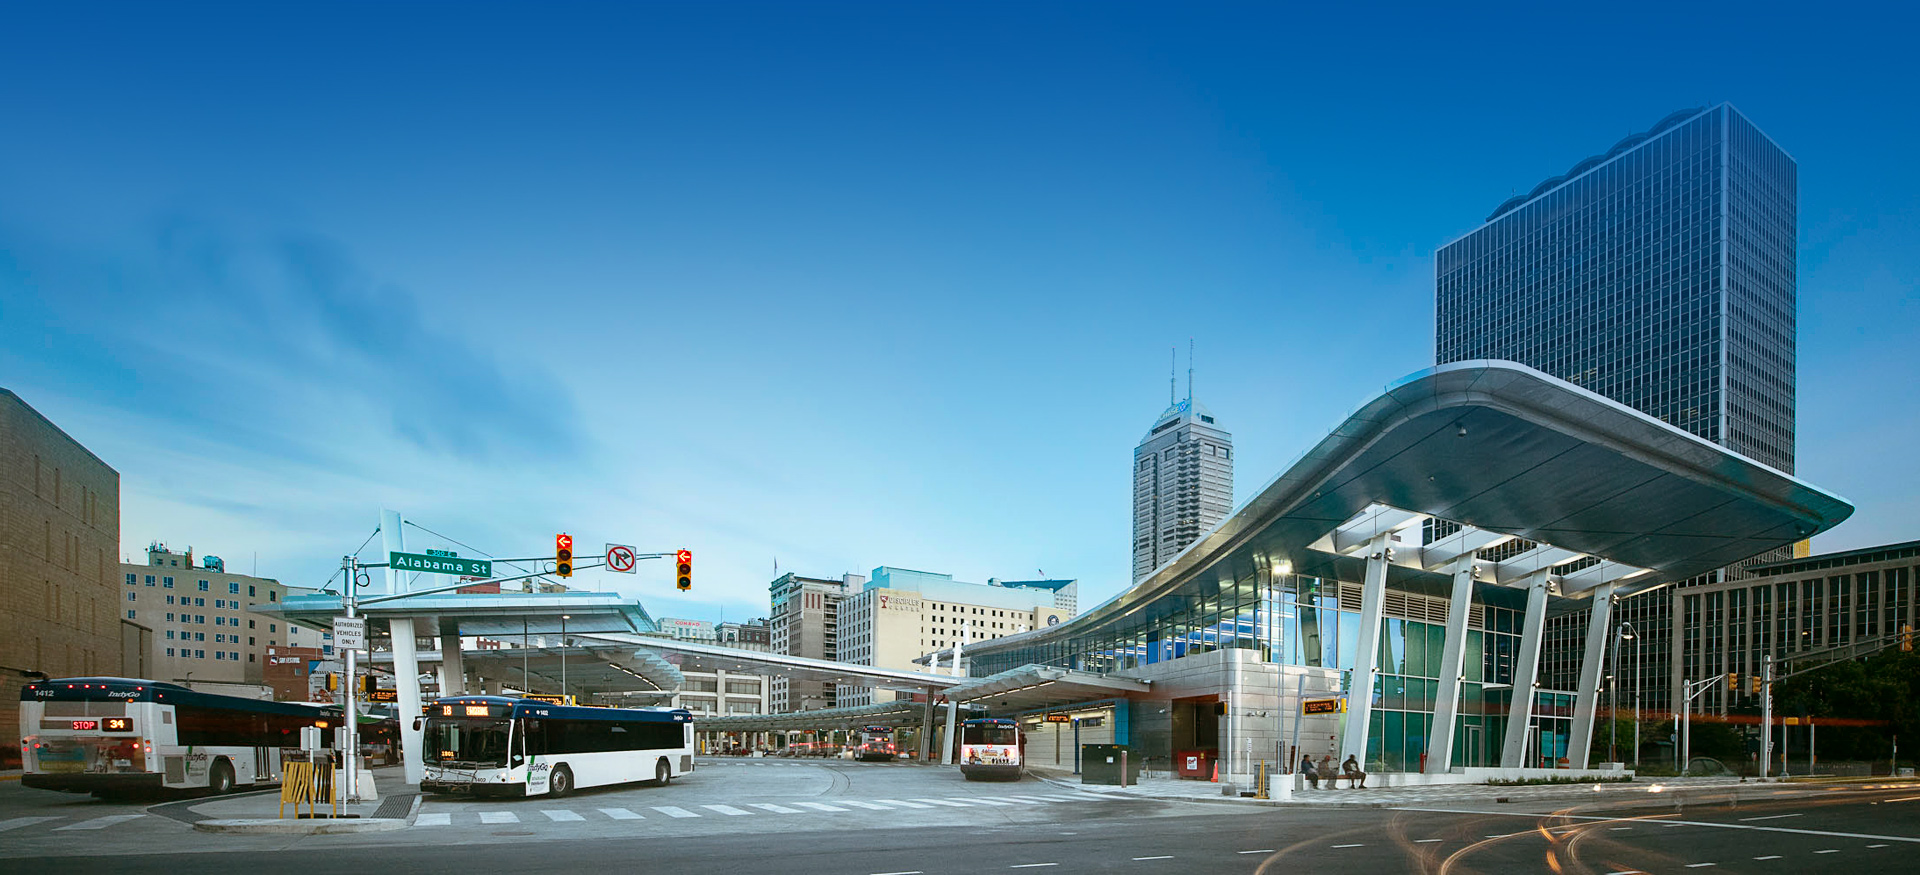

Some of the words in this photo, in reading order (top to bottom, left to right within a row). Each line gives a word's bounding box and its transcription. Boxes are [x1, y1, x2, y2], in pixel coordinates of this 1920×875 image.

[396, 556, 464, 572] Alabama
[471, 563, 487, 574] St
[335, 621, 364, 629] AUTHORIZED
[442, 705, 452, 716] 18
[73, 721, 95, 730] STOP
[109, 719, 125, 729] 34
[185, 753, 208, 762] IndyGo
[527, 762, 549, 772] IndyGo
